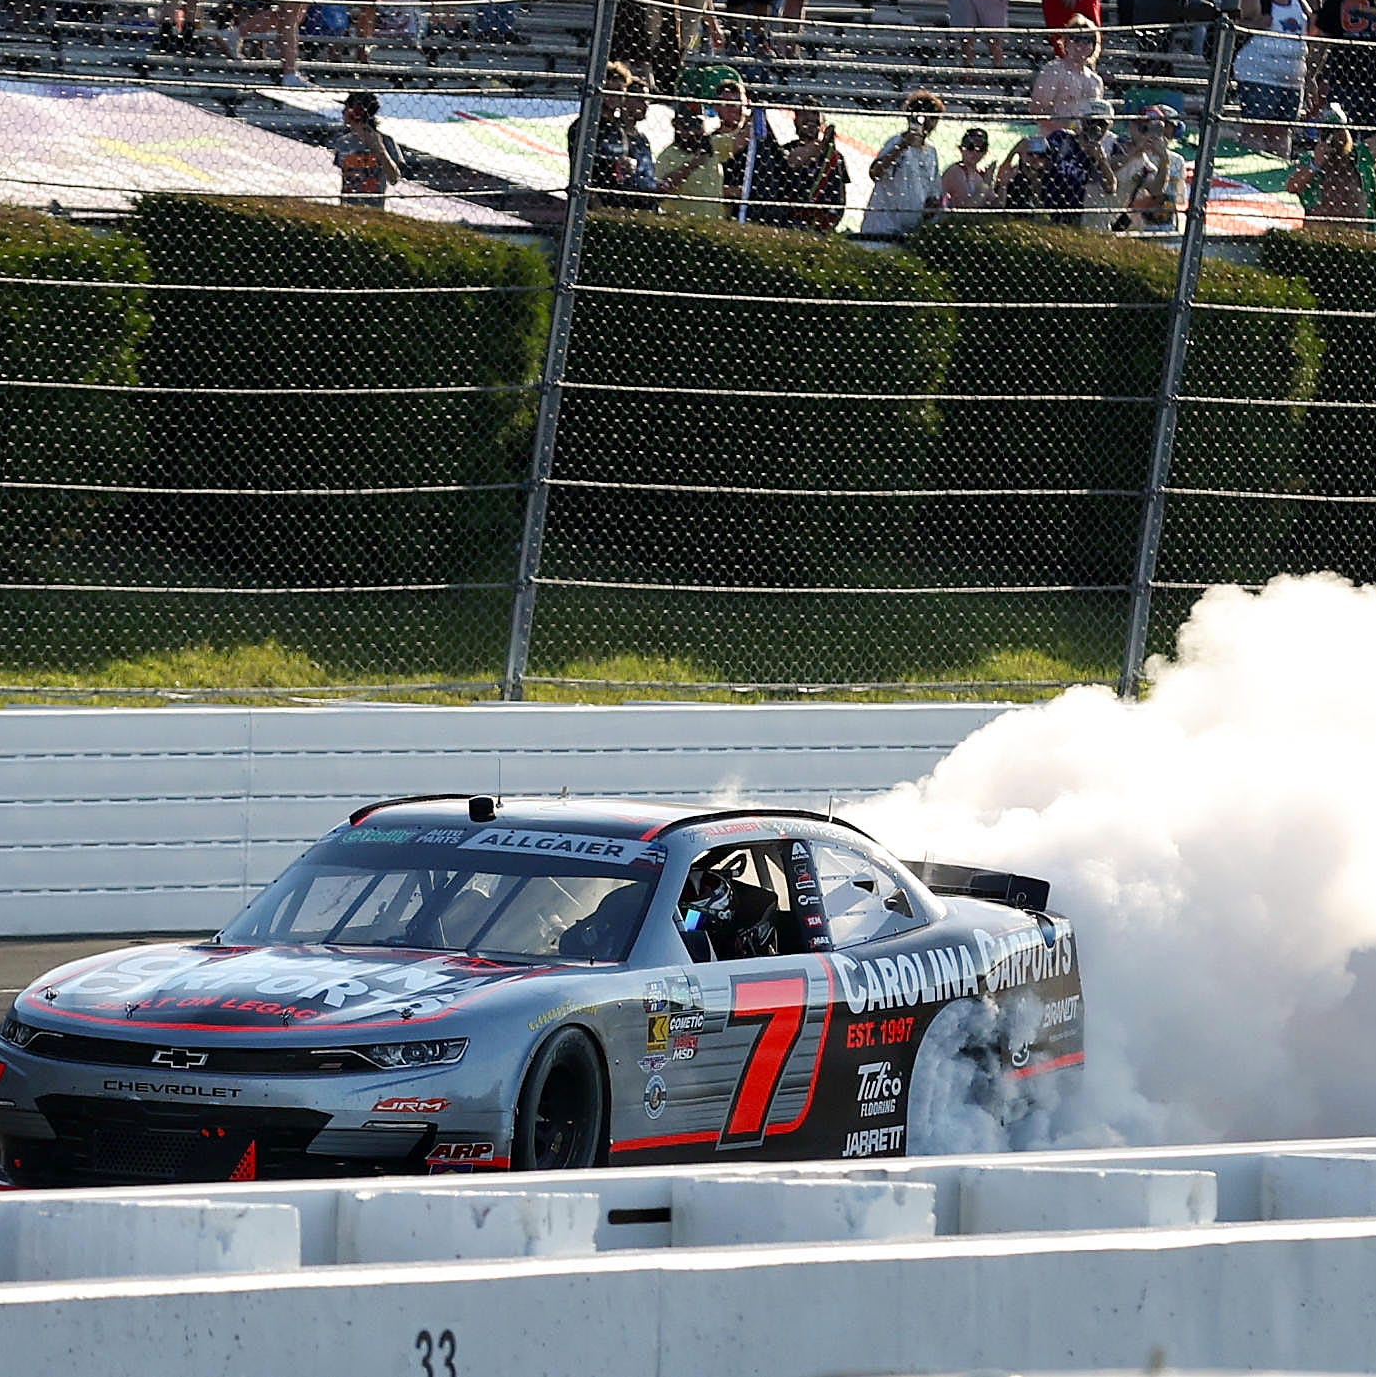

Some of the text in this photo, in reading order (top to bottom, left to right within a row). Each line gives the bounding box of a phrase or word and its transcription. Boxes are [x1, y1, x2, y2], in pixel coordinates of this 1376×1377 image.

[478, 833, 624, 858] ALLGAIER
[830, 944, 980, 1015] CAROLINA
[846, 1017, 916, 1049] EST. 1997
[672, 1048, 694, 1062] MSD
[722, 973, 808, 1141] 7
[103, 1080, 242, 1098] CHEVROLET
[857, 1062, 902, 1102] Tufco
[377, 1101, 443, 1112] JRM
[860, 1099, 896, 1118] FLOORING
[429, 1143, 493, 1160] ARP
[415, 1329, 457, 1377] 33
